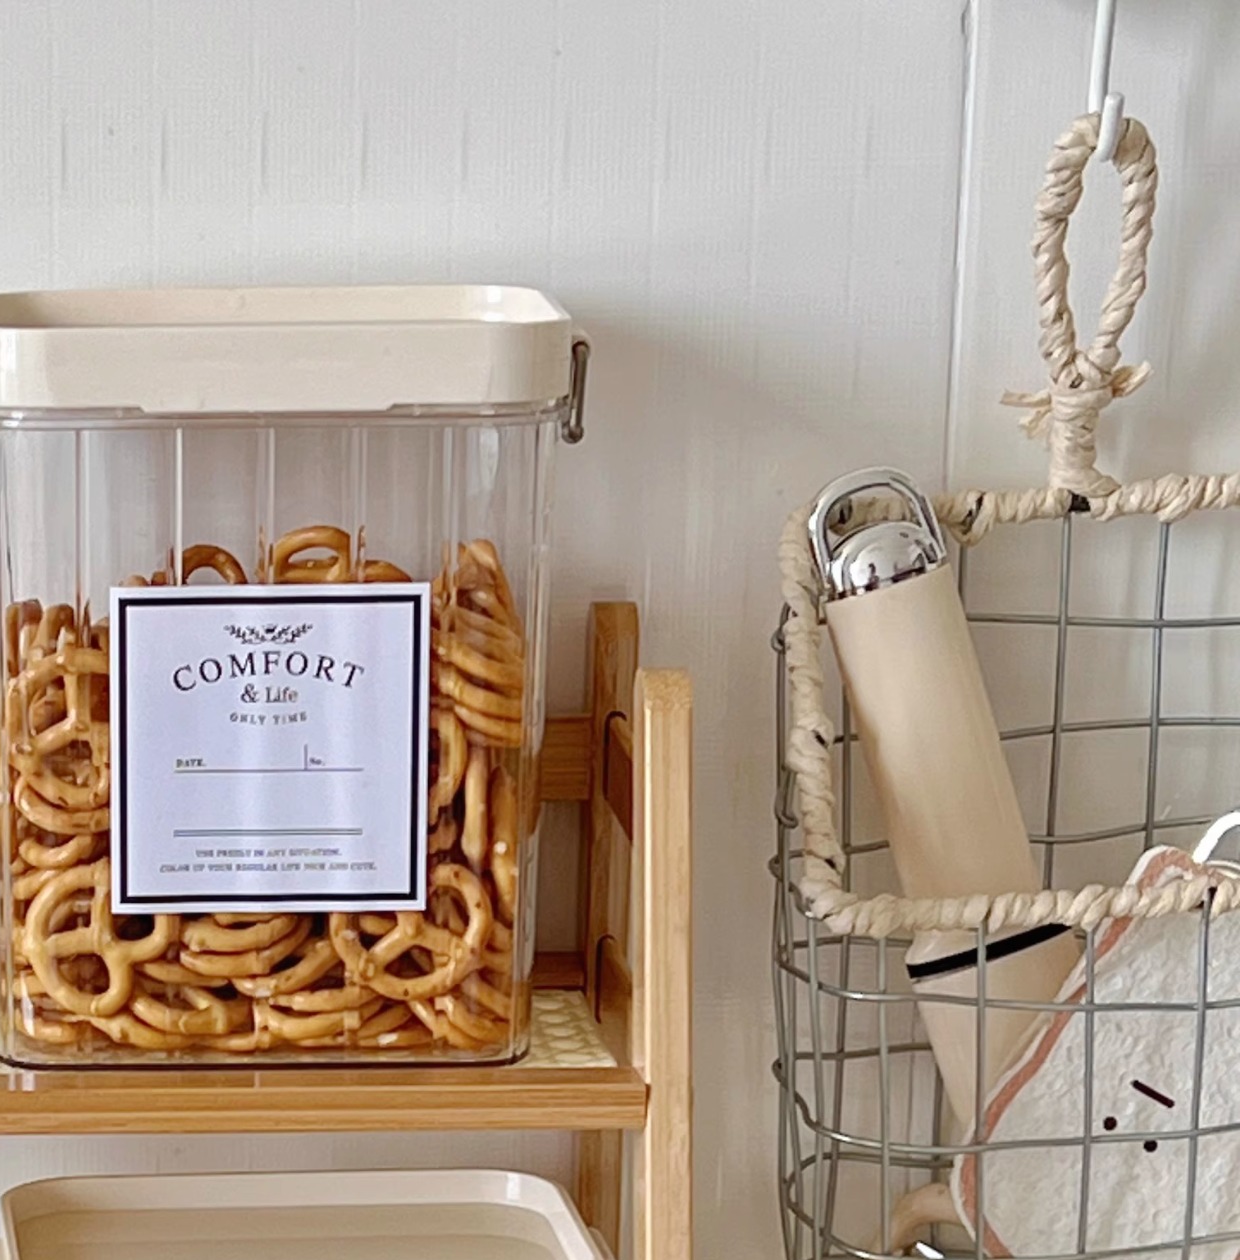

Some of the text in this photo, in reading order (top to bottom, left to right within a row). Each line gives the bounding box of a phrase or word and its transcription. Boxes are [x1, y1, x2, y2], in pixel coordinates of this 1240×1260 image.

[173, 651, 364, 692] COMFORT
[240, 684, 299, 703] & Life
[229, 711, 307, 725] ONLY TIME
